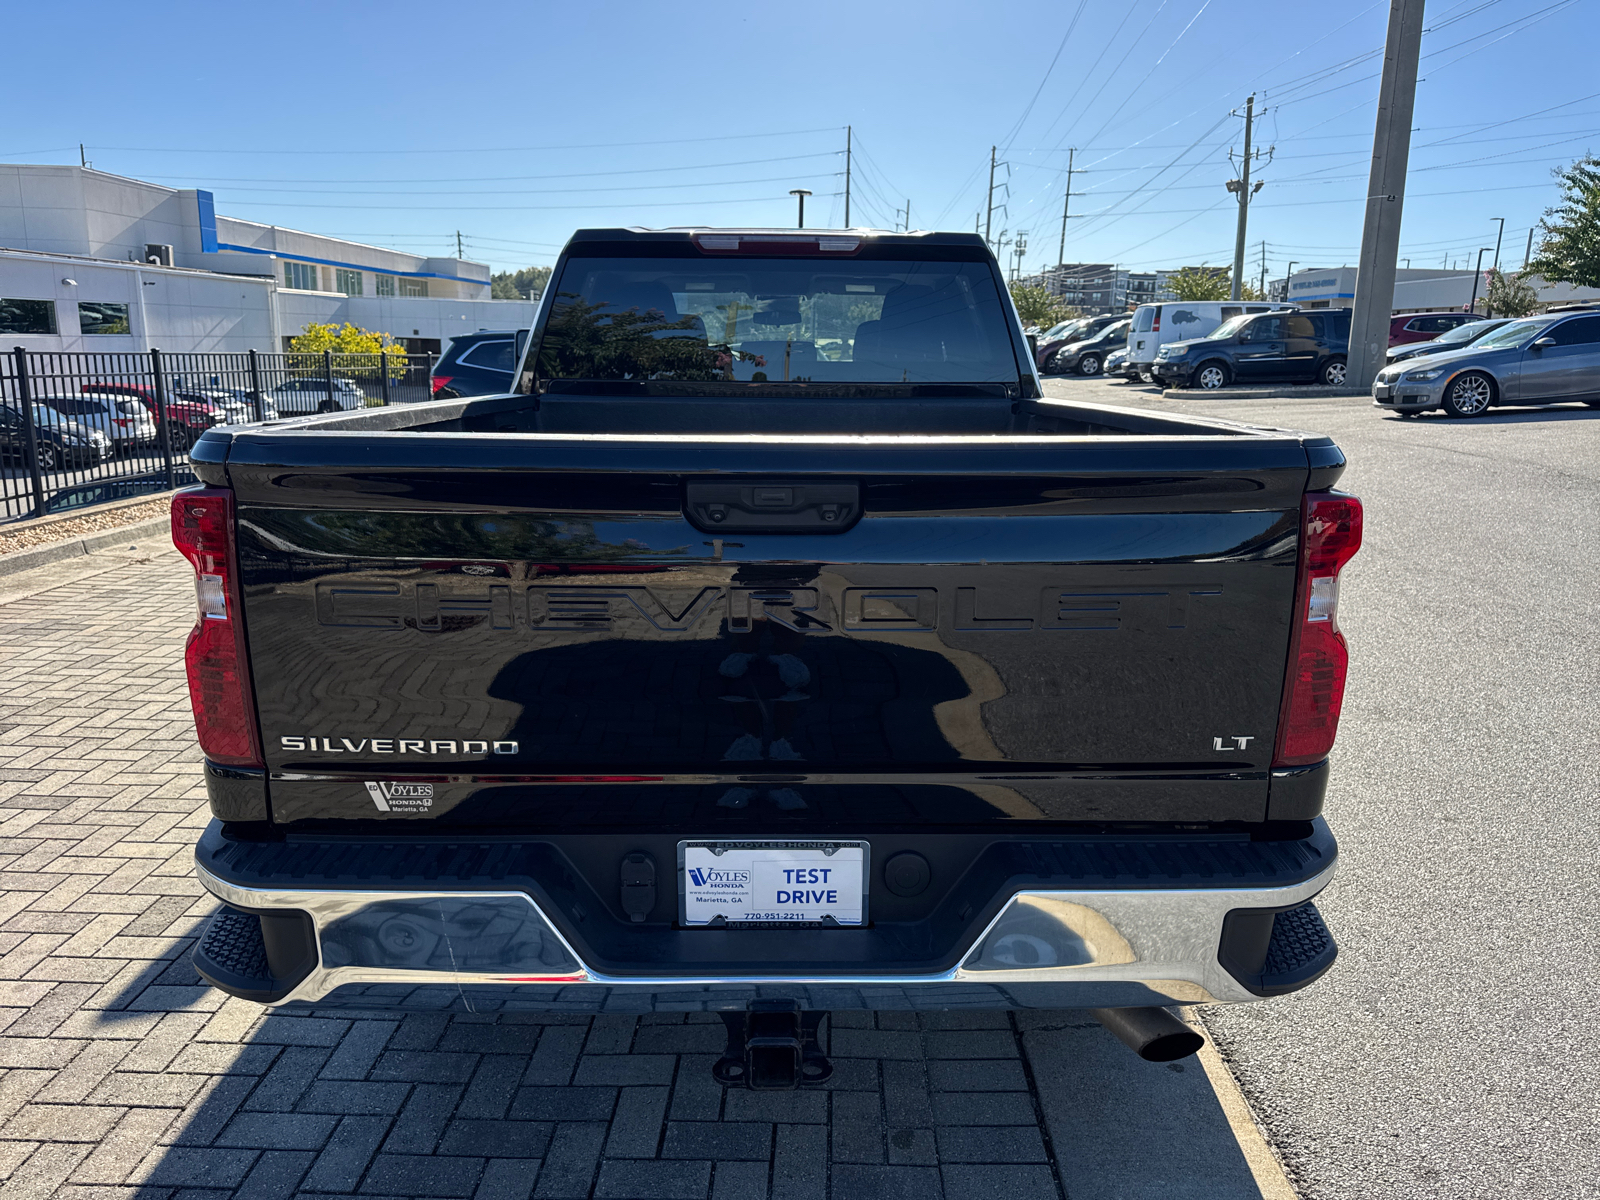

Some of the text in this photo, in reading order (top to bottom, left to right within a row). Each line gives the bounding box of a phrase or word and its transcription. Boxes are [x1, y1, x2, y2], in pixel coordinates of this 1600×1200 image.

[315, 583, 1223, 632] CHEVROLET
[281, 736, 519, 754] SILVERADO
[1213, 736, 1254, 750] LT
[379, 781, 432, 799] VOYLES
[696, 867, 749, 885] VOYLES
[783, 868, 831, 884] TEST
[776, 890, 838, 904] DRIVE
